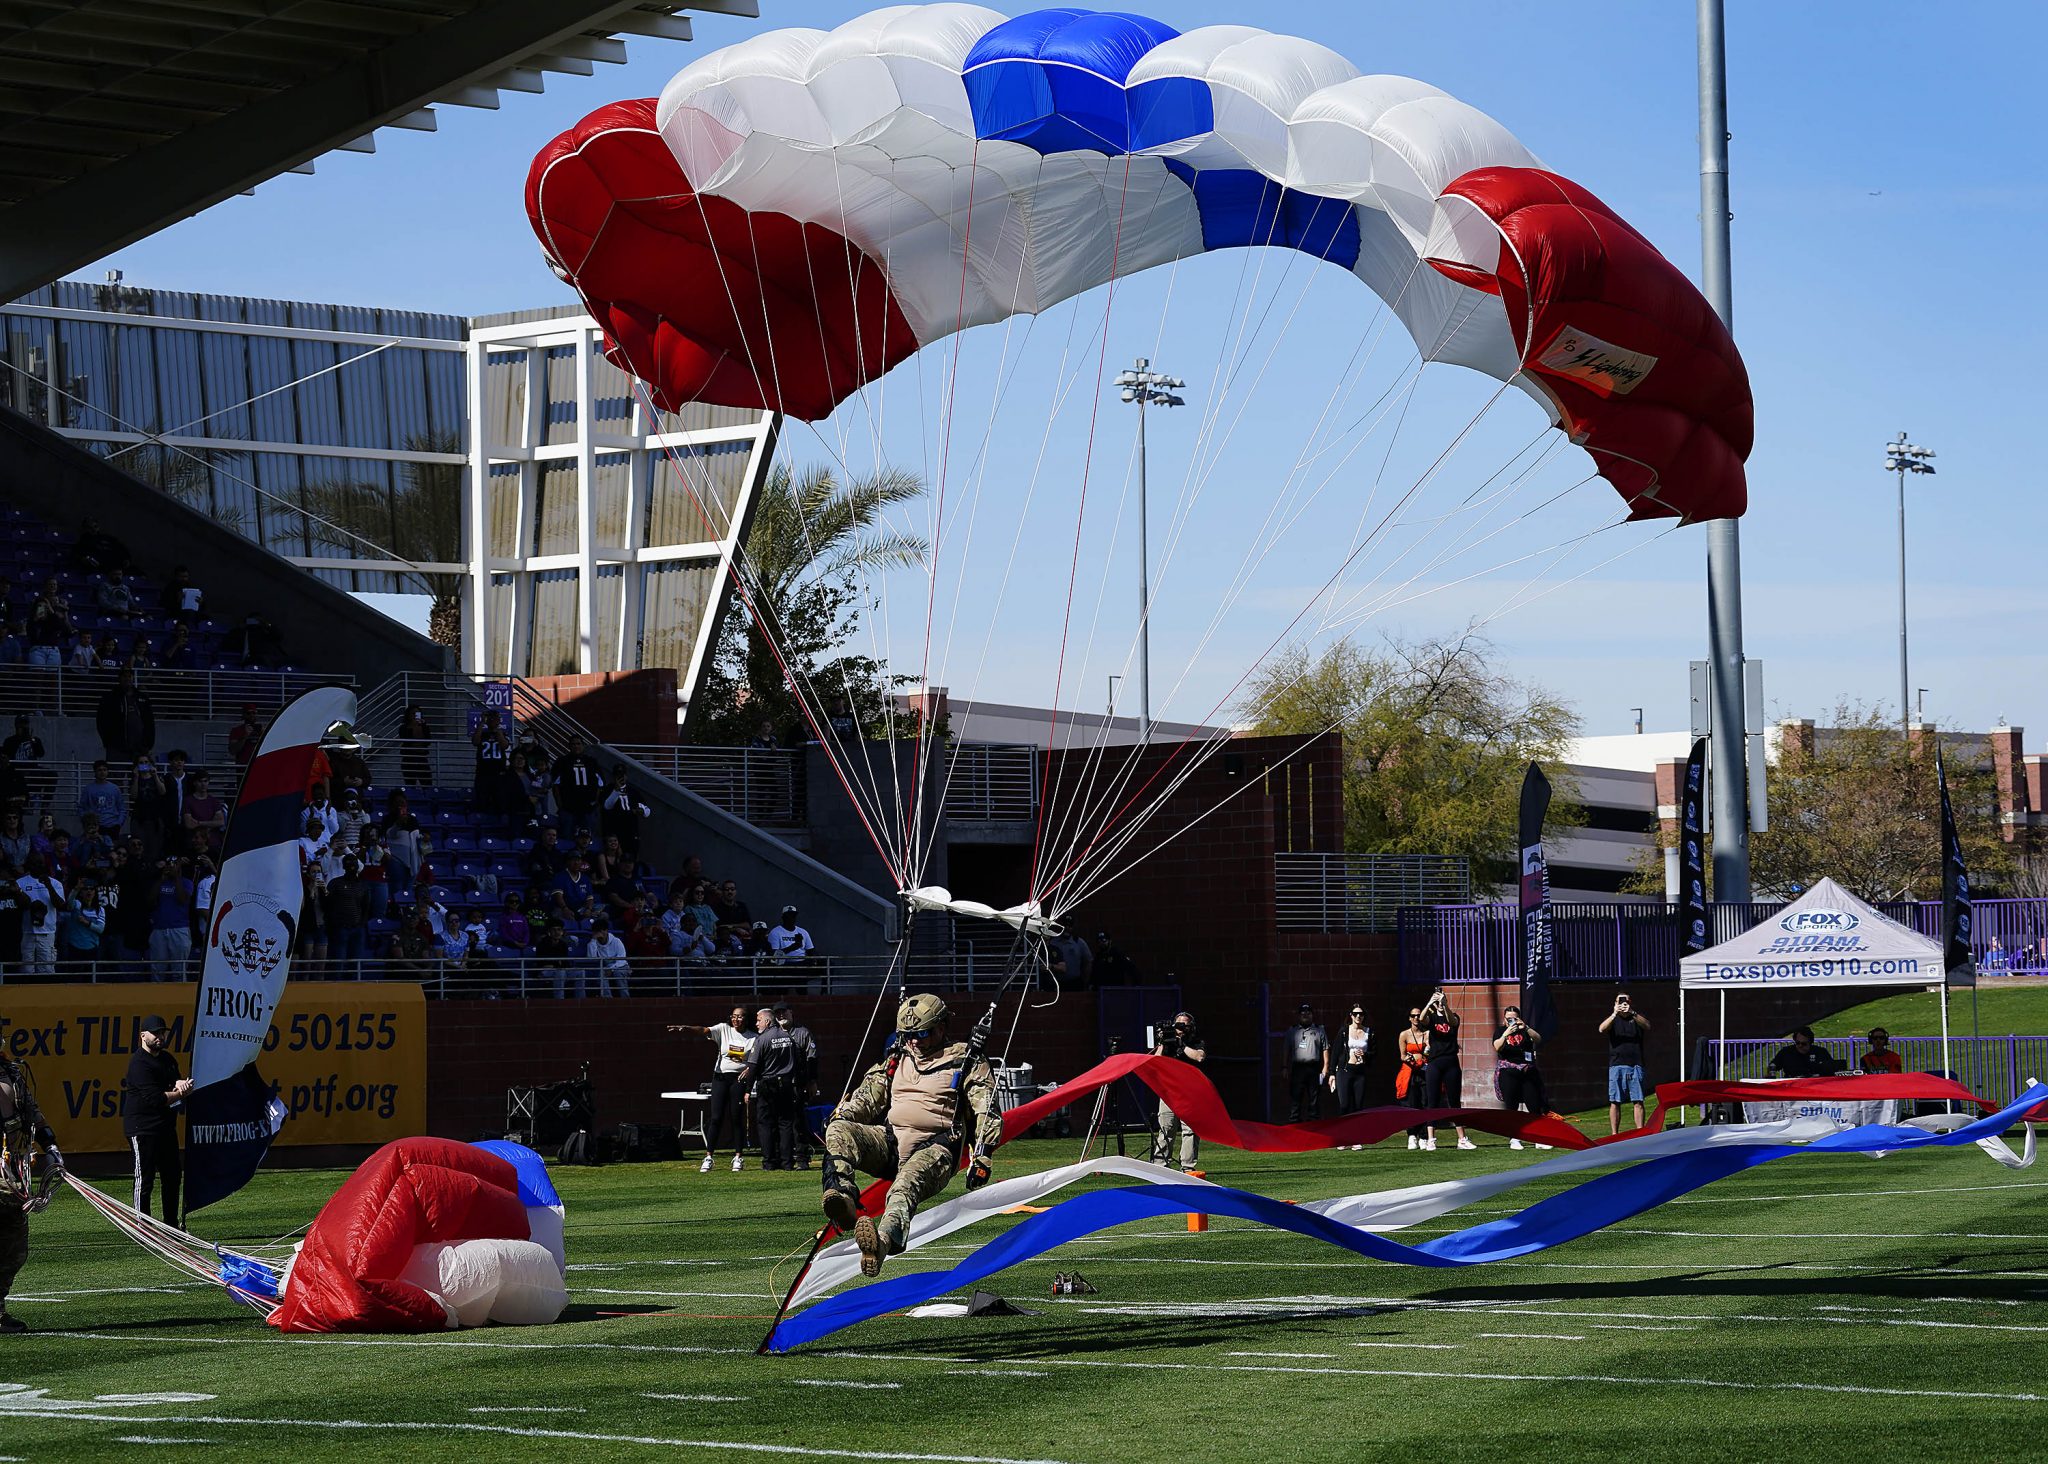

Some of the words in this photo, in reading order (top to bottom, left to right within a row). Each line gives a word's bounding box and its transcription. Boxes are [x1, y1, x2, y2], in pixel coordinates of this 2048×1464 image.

[1582, 352, 1643, 384] Lightning
[485, 689, 510, 706] 201
[573, 766, 588, 786] 11
[1797, 913, 1842, 925] FOX
[1757, 945, 1870, 955] PHOENIX
[1772, 935, 1861, 947] 910AM
[1705, 957, 1918, 983] Foxsports910.com
[205, 986, 263, 1023] FROG
[288, 1012, 397, 1052] 50155
